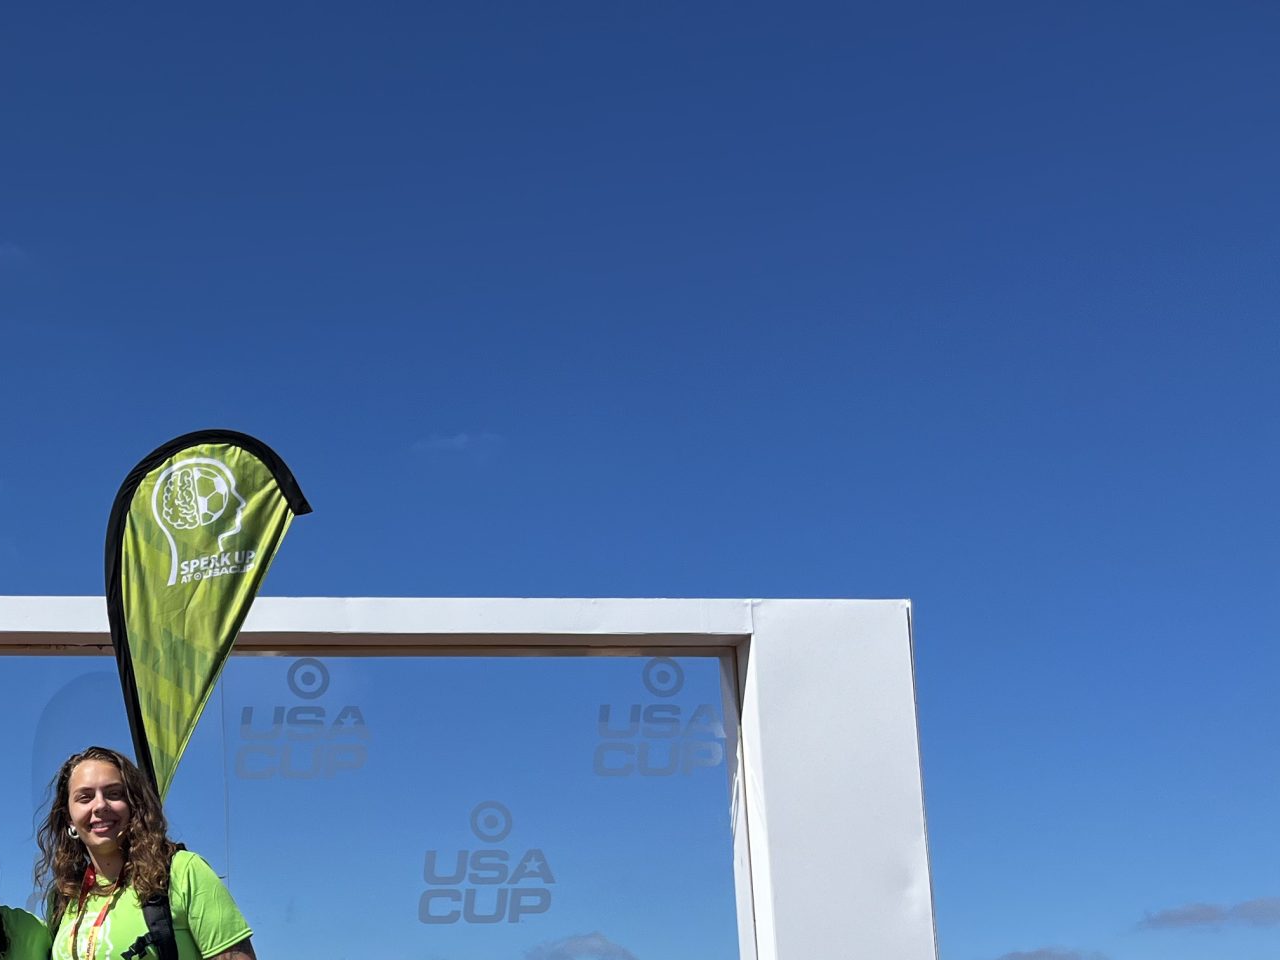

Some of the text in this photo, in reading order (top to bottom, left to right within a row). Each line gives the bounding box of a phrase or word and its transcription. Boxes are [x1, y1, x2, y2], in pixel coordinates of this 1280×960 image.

[234, 550, 256, 564] UP
[180, 573, 193, 584] AT
[240, 706, 372, 741] USA
[598, 704, 726, 738] USA
[234, 744, 367, 779] CUP
[593, 742, 723, 776] CUP
[423, 849, 555, 884] USA
[418, 889, 551, 924] CUP
